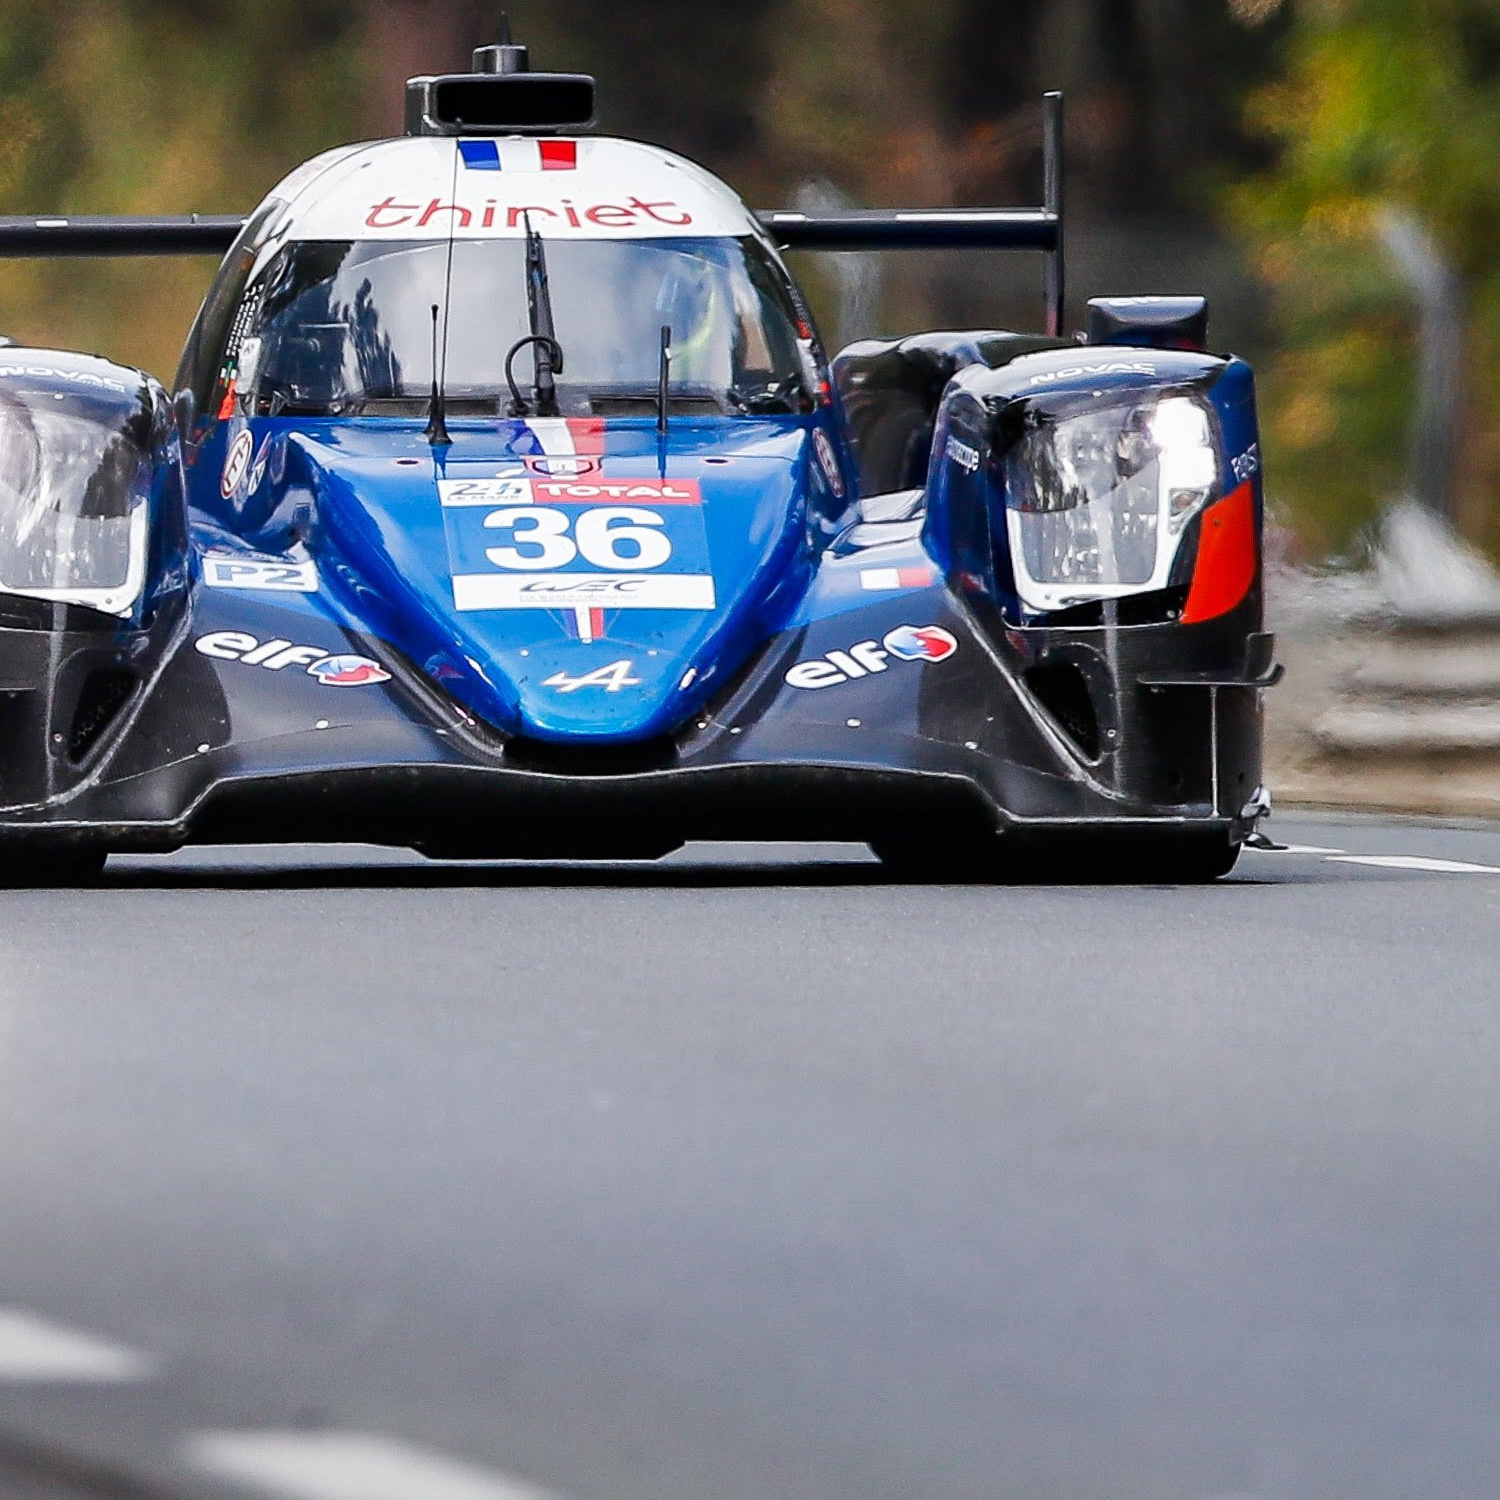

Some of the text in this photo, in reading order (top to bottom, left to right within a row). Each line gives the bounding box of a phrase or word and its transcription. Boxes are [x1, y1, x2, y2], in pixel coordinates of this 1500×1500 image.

[364, 196, 693, 228] thiriet
[536, 483, 691, 498] TOTAL
[482, 506, 672, 570] 36
[214, 563, 305, 587] P2
[194, 630, 330, 672] elf
[784, 640, 890, 690] elf
